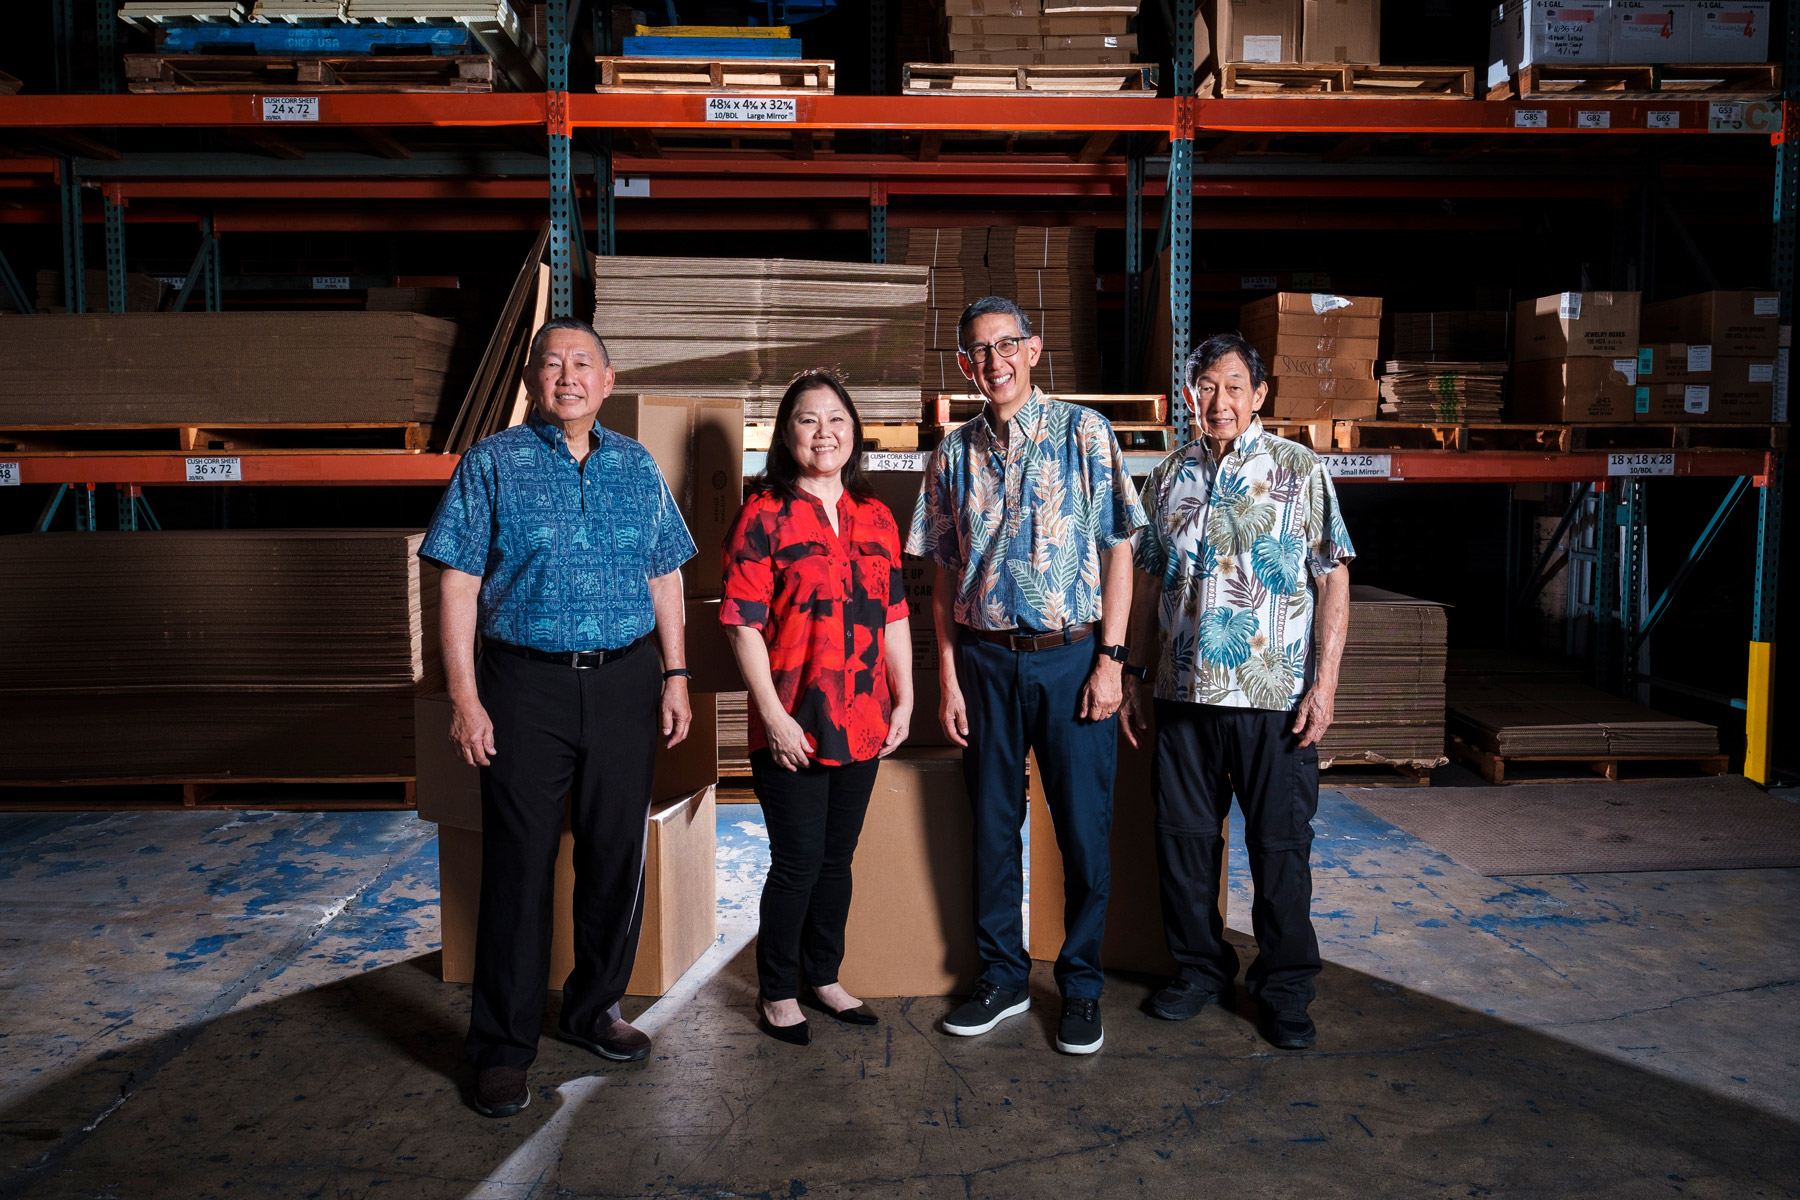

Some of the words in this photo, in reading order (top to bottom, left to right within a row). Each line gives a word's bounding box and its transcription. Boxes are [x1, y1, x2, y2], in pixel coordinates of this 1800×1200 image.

[318, 38, 340, 48] USA
[272, 104, 285, 113] 24
[296, 104, 309, 113] 72
[714, 112, 738, 120] 10/BDL
[1745, 104, 1768, 130] C
[1342, 457, 1348, 466] 4
[1360, 456, 1372, 466] 26
[1611, 455, 1624, 464] 18
[1636, 455, 1648, 464] 18
[1659, 455, 1672, 464] 28
[878, 460, 890, 469] 48
[902, 460, 913, 469] 72
[195, 465, 208, 474] 36
[219, 465, 231, 473] 72
[911, 569, 923, 579] UP
